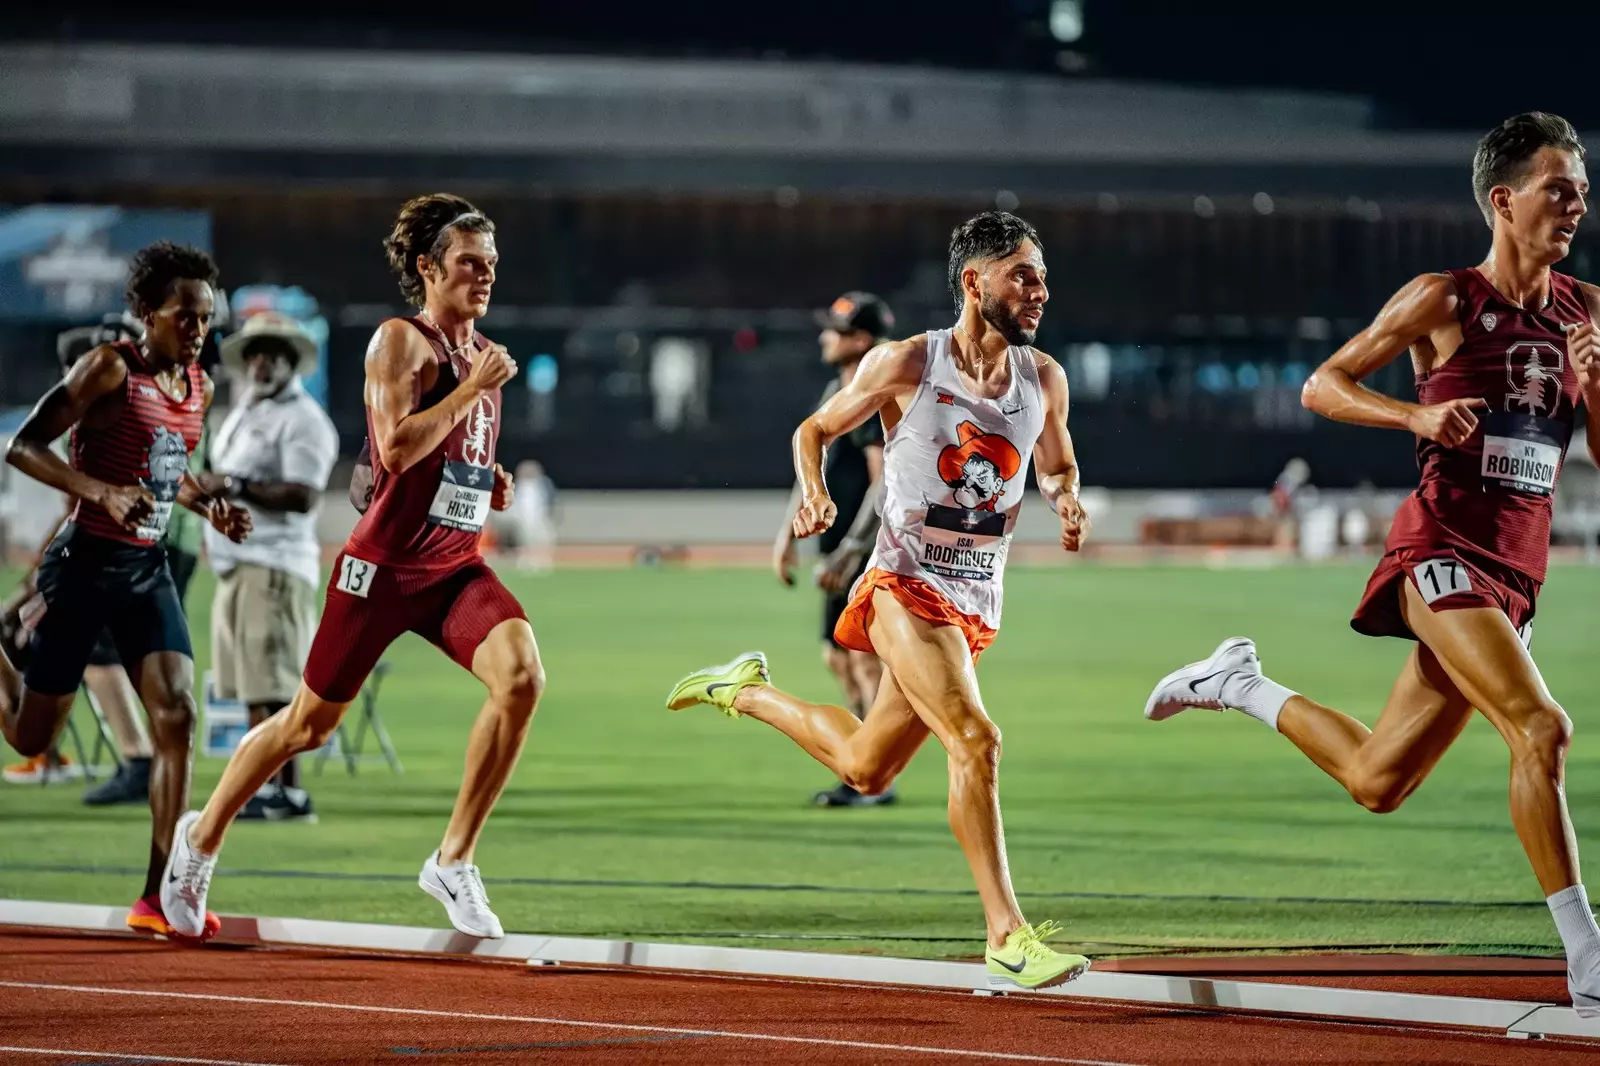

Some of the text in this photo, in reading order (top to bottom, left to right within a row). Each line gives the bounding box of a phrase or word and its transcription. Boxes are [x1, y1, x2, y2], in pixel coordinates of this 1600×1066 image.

[1524, 445, 1537, 458] KY
[1486, 454, 1555, 484] ROBINSON
[446, 500, 476, 520] HICKS
[924, 542, 995, 569] RODRIGUEZ
[956, 536, 974, 548] ISAI
[346, 559, 368, 592] 13
[1423, 561, 1457, 595] 17
